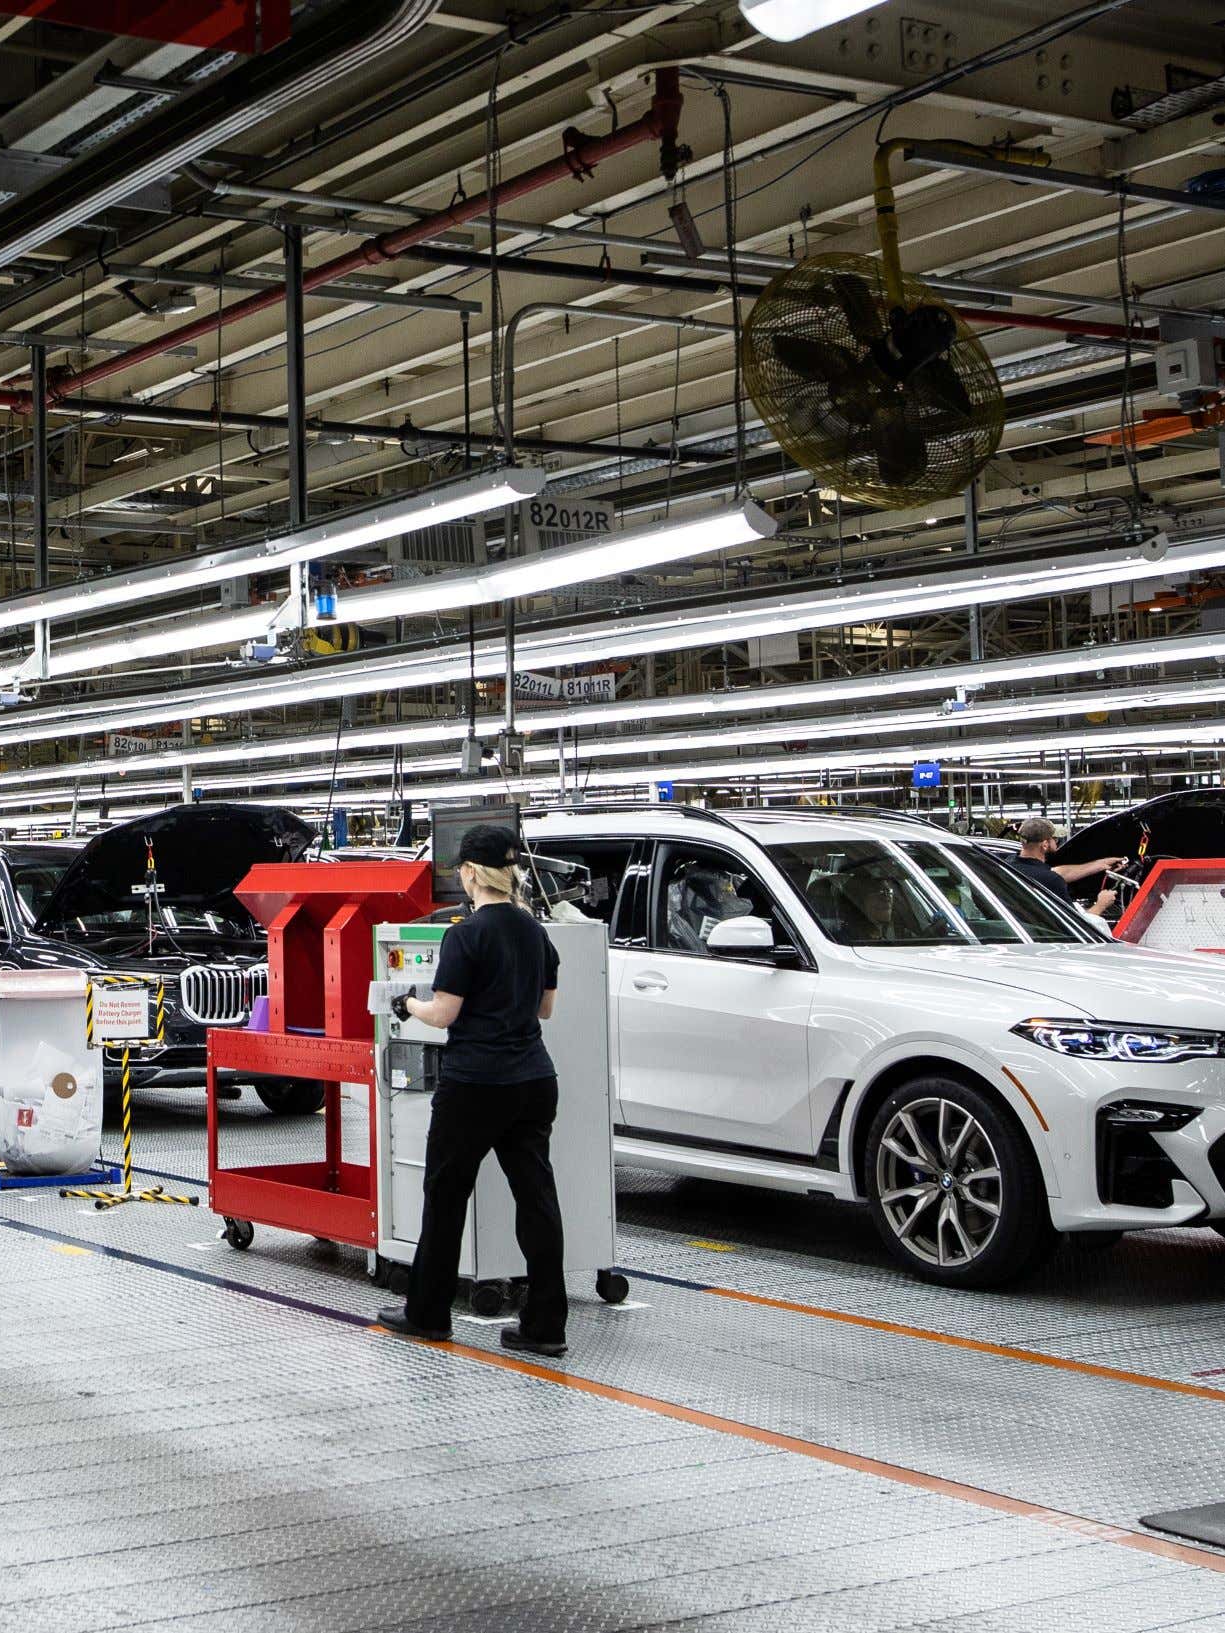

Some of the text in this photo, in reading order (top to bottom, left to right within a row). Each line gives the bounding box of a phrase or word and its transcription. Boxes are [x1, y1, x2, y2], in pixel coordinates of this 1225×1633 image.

[530, 502, 610, 530] 82012R
[514, 673, 555, 696] 82011L
[567, 679, 611, 696] 81011R
[98, 1009, 120, 1018] Battery
[116, 1018, 127, 1026] this
